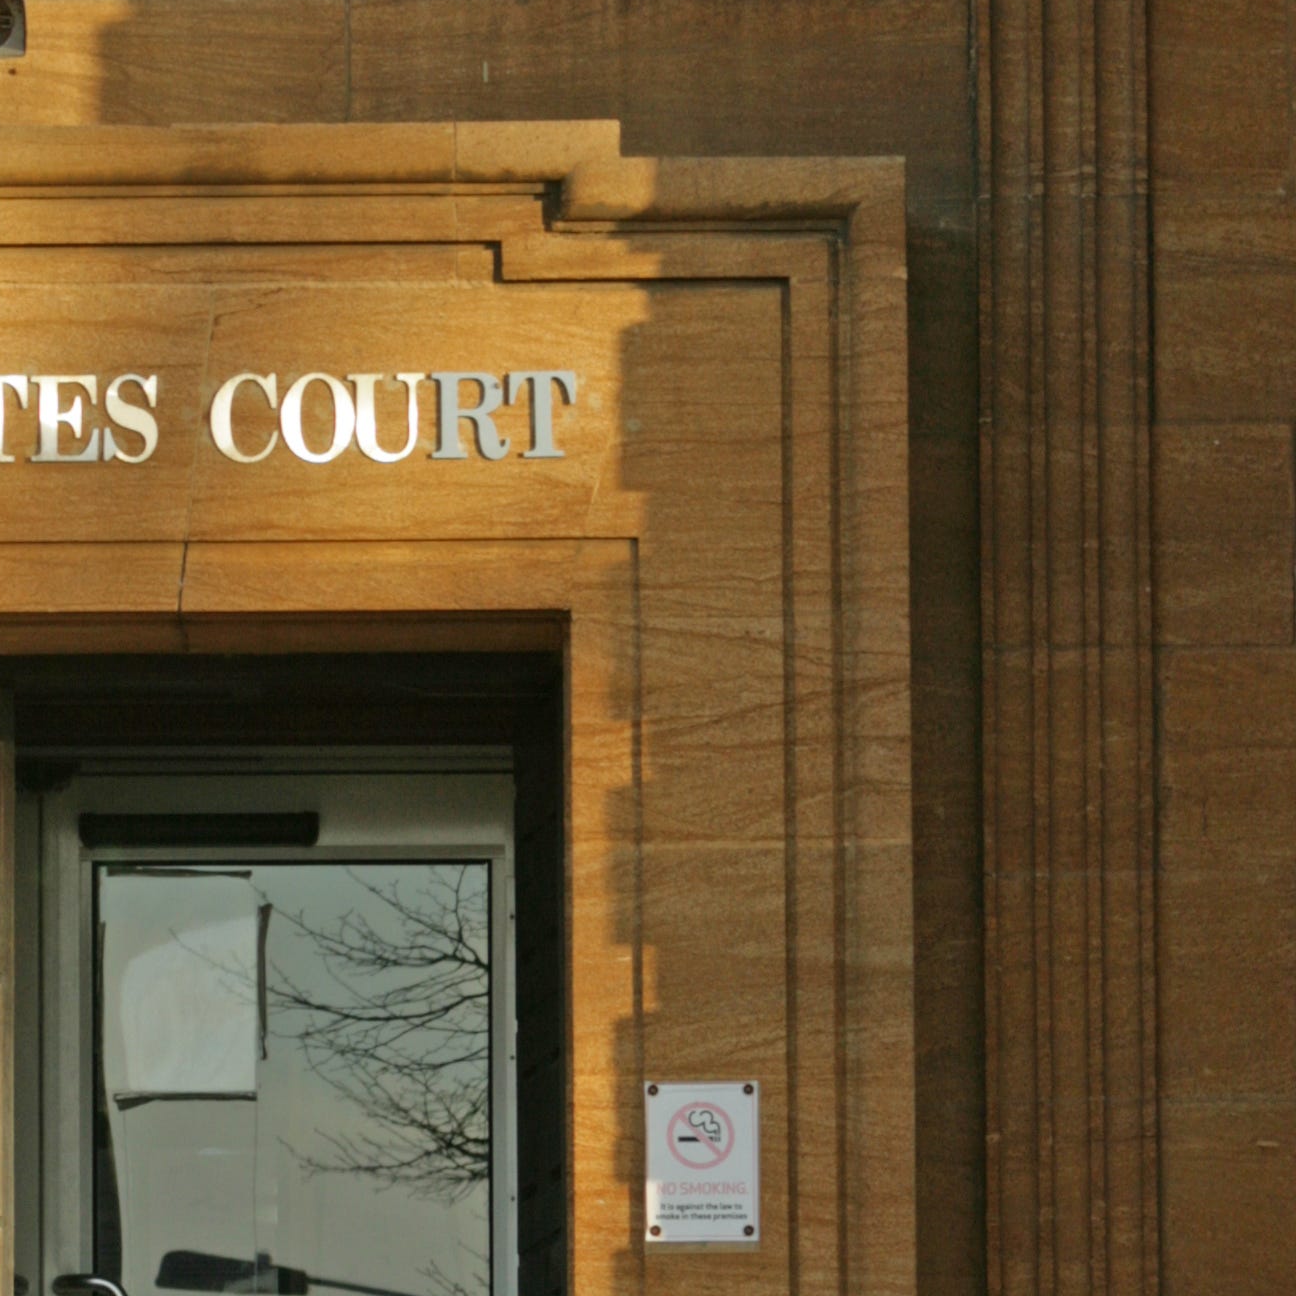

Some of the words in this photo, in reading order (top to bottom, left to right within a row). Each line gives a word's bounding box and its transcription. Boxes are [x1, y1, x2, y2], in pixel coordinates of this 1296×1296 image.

[210, 370, 576, 462] COURT
[657, 1182, 677, 1195] NO
[676, 1203, 704, 1212] against
